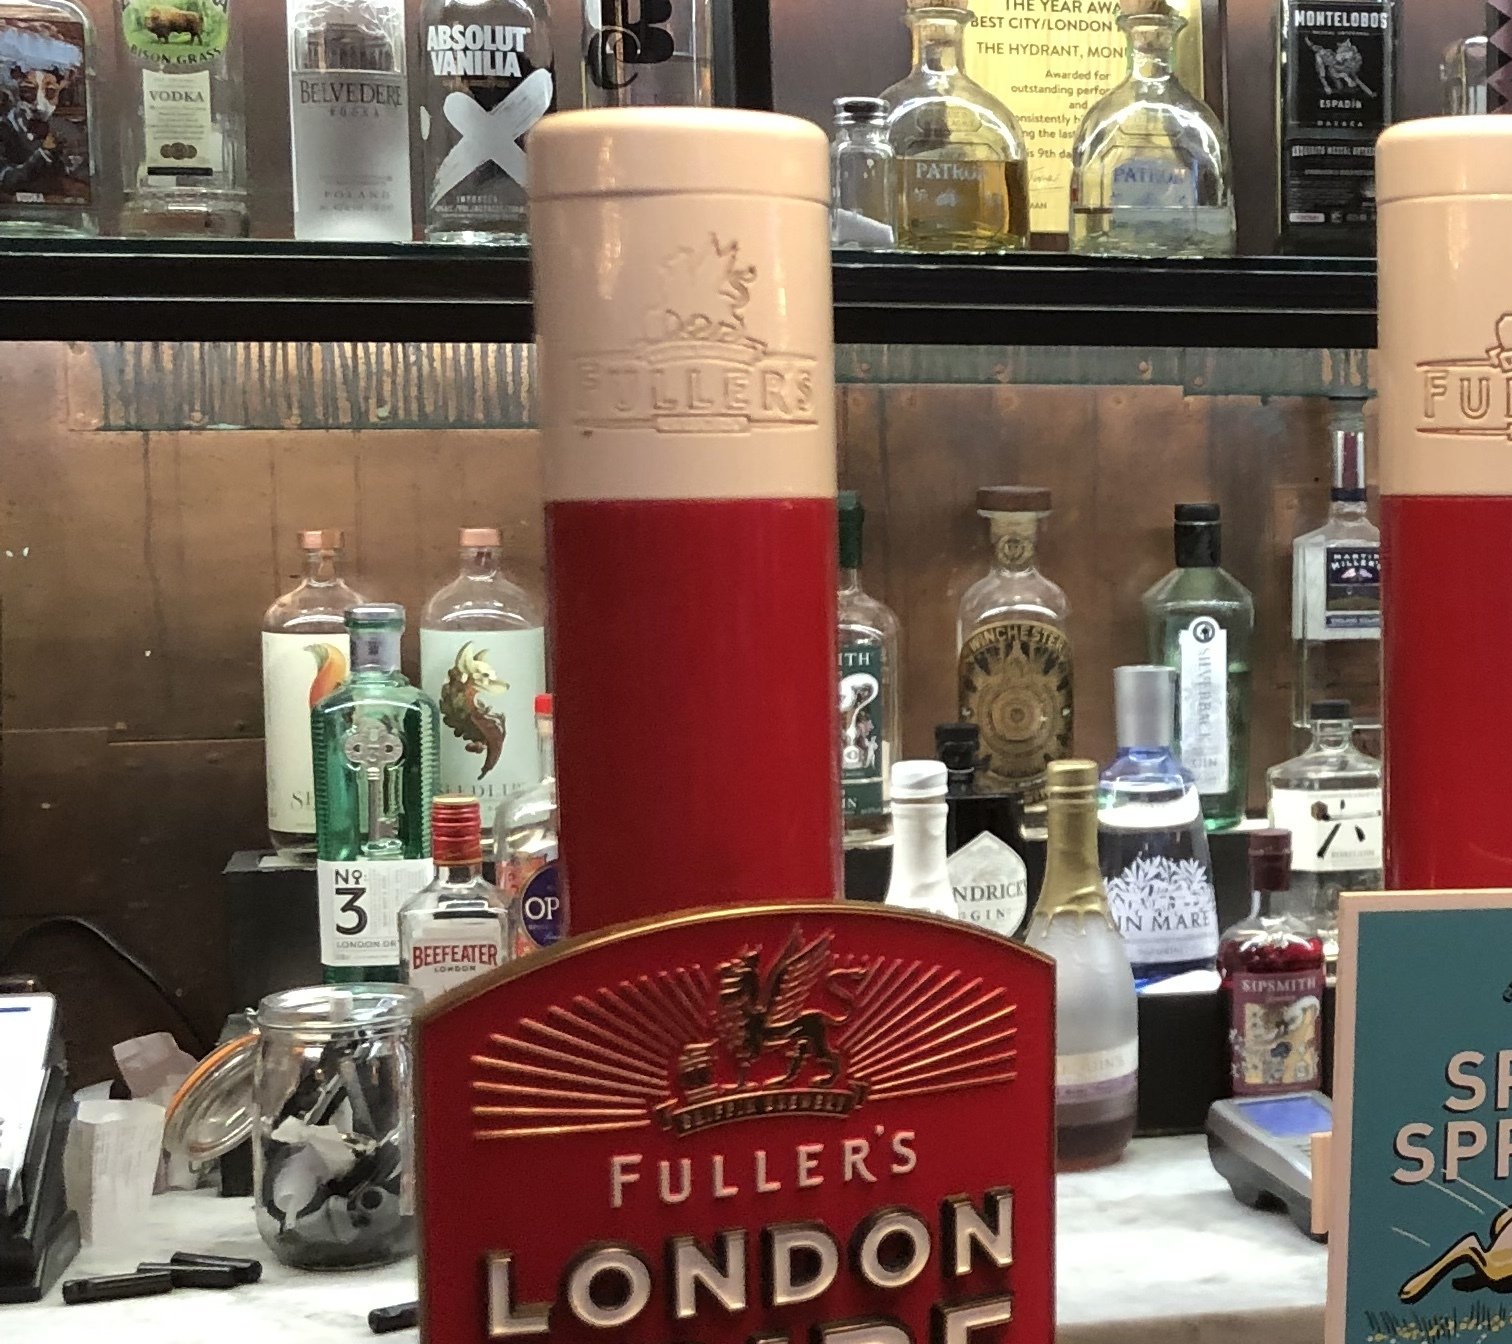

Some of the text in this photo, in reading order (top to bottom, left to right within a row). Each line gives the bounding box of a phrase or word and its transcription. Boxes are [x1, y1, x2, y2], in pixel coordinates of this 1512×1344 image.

[1040, 0, 1082, 13] YEAR
[970, 16, 1113, 32] BEST CITY/LONDON
[1293, 10, 1389, 29] MONTELOBOS
[427, 24, 527, 52] ABSOLUT
[129, 43, 222, 66] BISON GRASS
[976, 42, 1004, 55] THE
[1008, 43, 1084, 59] HYDRANT,
[430, 51, 523, 78] VANILIA
[1045, 70, 1111, 81] Awarded for
[149, 90, 205, 104] VODKA
[300, 79, 403, 107] BELVEDERE
[1010, 84, 1074, 97] outstanding
[1069, 99, 1088, 110] and
[1038, 129, 1056, 139] the
[1037, 148, 1057, 159] 9th
[323, 190, 391, 201] POLAND
[967, 625, 1066, 654] WINCHESTER
[1192, 757, 1218, 768] GIN
[335, 887, 368, 936] 3
[970, 907, 1007, 923] GIN
[1160, 908, 1210, 933] MARE
[336, 939, 377, 949] LONDON
[412, 943, 499, 971] BEEFEATER
[434, 965, 477, 973] LONDON
[1241, 977, 1317, 992] SIPSMITH
[609, 1124, 919, 1209] FULLER'S
[484, 1186, 1016, 1340] LONDON
